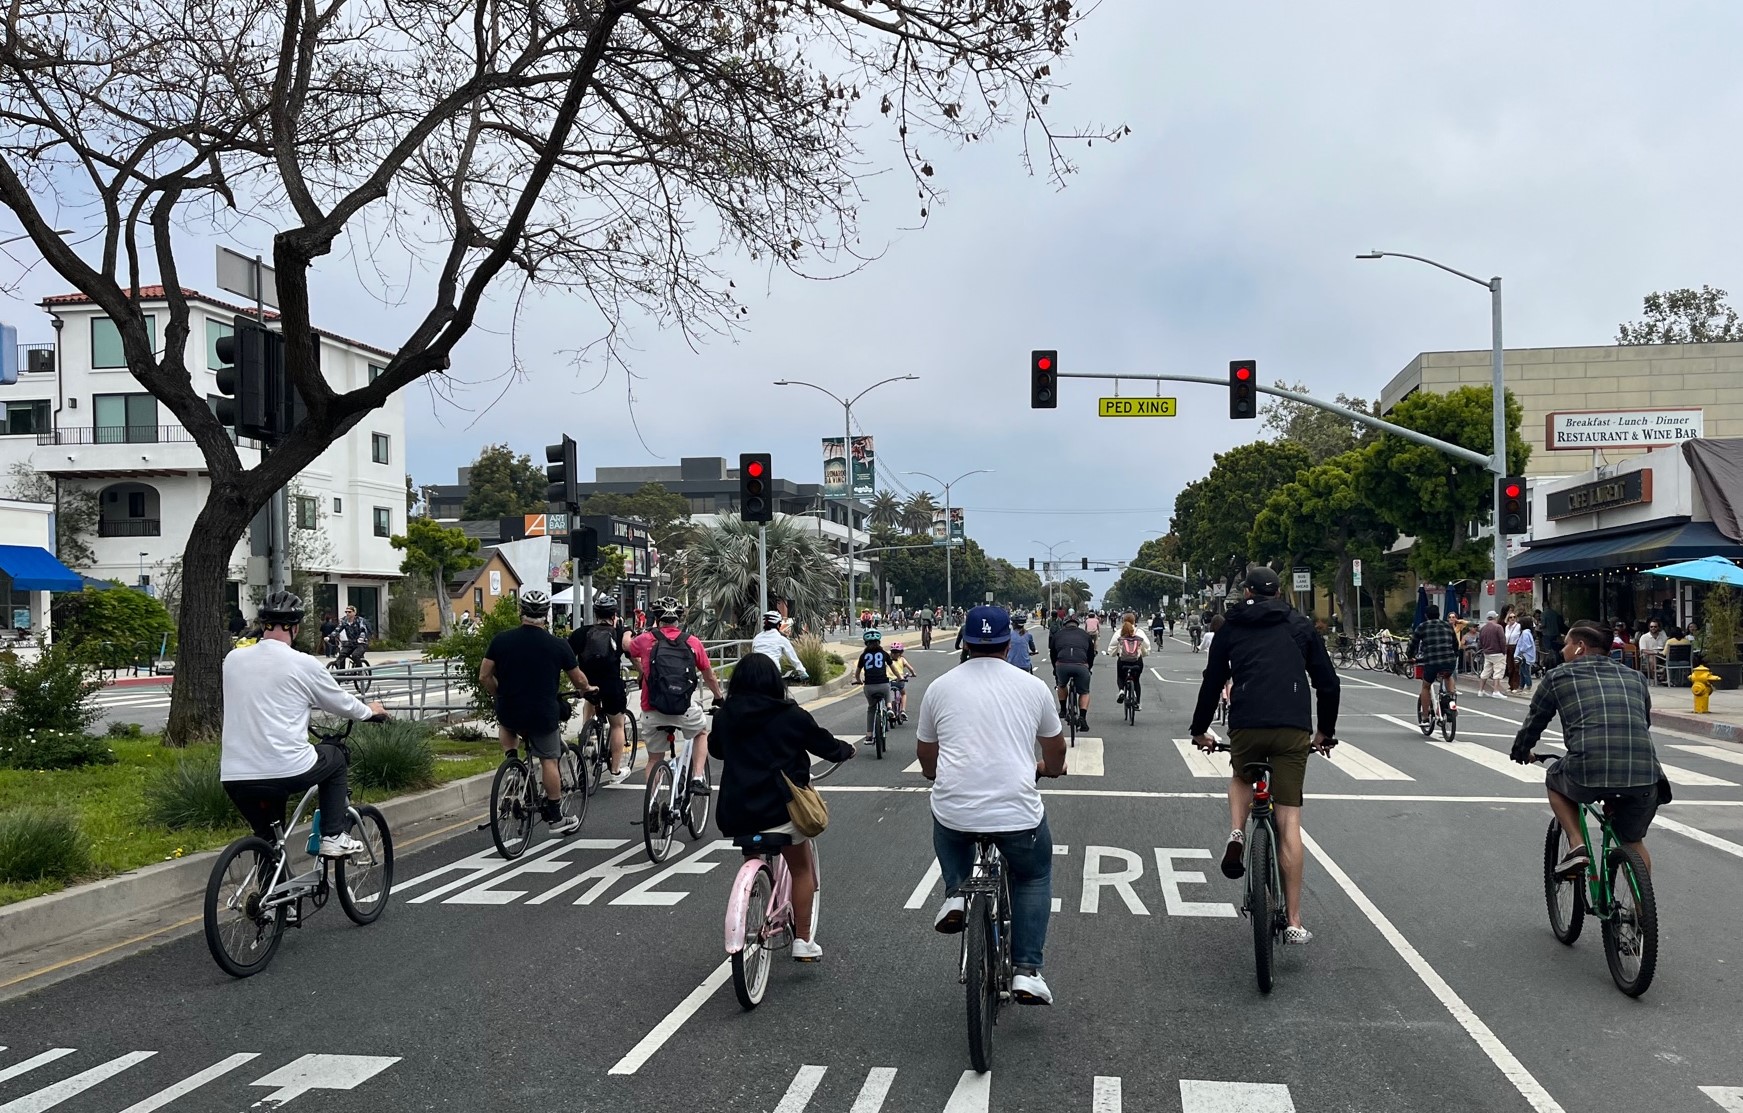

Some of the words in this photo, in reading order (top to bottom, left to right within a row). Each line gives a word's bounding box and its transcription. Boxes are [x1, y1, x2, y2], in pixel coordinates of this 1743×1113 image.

[1106, 401, 1132, 413] PED
[1138, 401, 1169, 413] XING
[1566, 418, 1610, 427] Breakfast
[1618, 417, 1648, 426] Lunch
[1656, 416, 1690, 425] Dinner
[1557, 431, 1629, 442] RESTAURANT
[1631, 431, 1639, 441] &
[1642, 428, 1672, 440] WINE
[1675, 427, 1697, 438] BAR
[549, 514, 565, 522] ART
[549, 522, 566, 530] BAR
[981, 618, 992, 634] LA
[864, 652, 884, 669] 28
[355, 838, 743, 906] HERE
